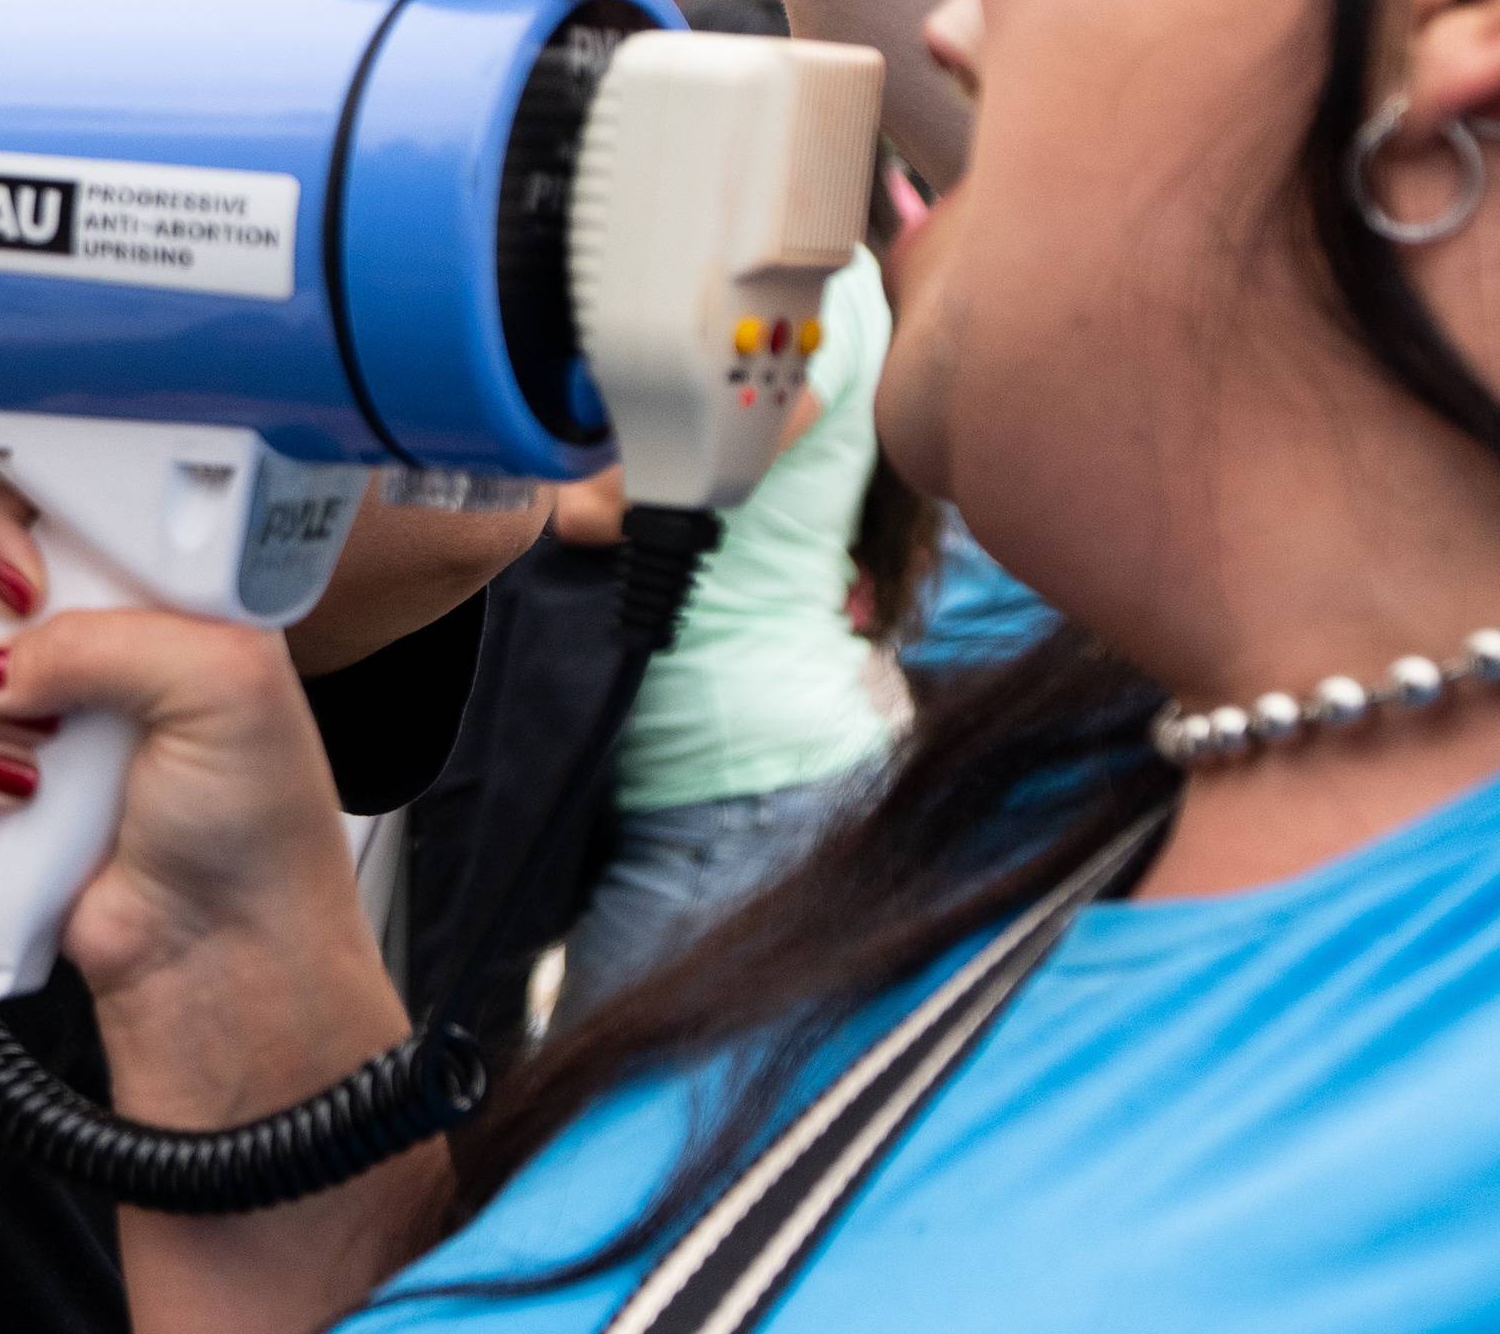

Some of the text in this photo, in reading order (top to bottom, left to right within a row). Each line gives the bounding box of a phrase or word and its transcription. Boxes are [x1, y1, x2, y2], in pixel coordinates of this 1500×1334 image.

[86, 183, 251, 216] PROGRESSIVE
[83, 213, 279, 250] ANTI-ABORTION
[83, 239, 194, 268] UPRISING
